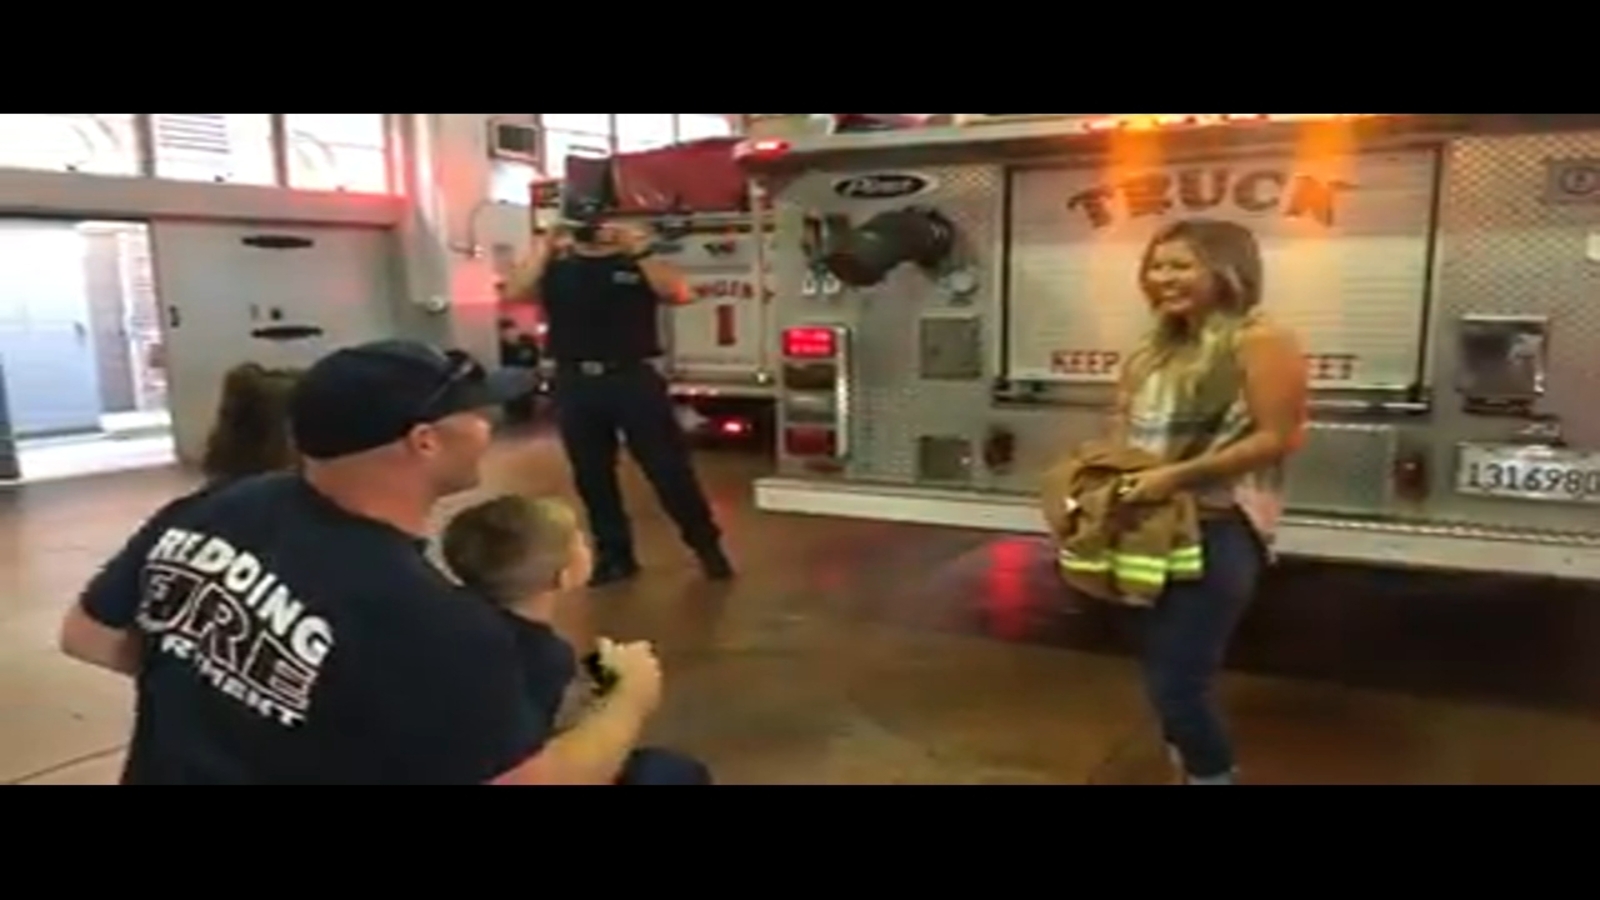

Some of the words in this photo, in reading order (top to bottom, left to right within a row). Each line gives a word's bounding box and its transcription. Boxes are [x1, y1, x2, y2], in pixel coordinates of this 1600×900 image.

[1067, 168, 1358, 228] TRUCK
[716, 304, 736, 347] 1
[1052, 351, 1120, 375] KEEP
[1468, 462, 1600, 494] 1316980
[147, 528, 335, 667] REDDING
